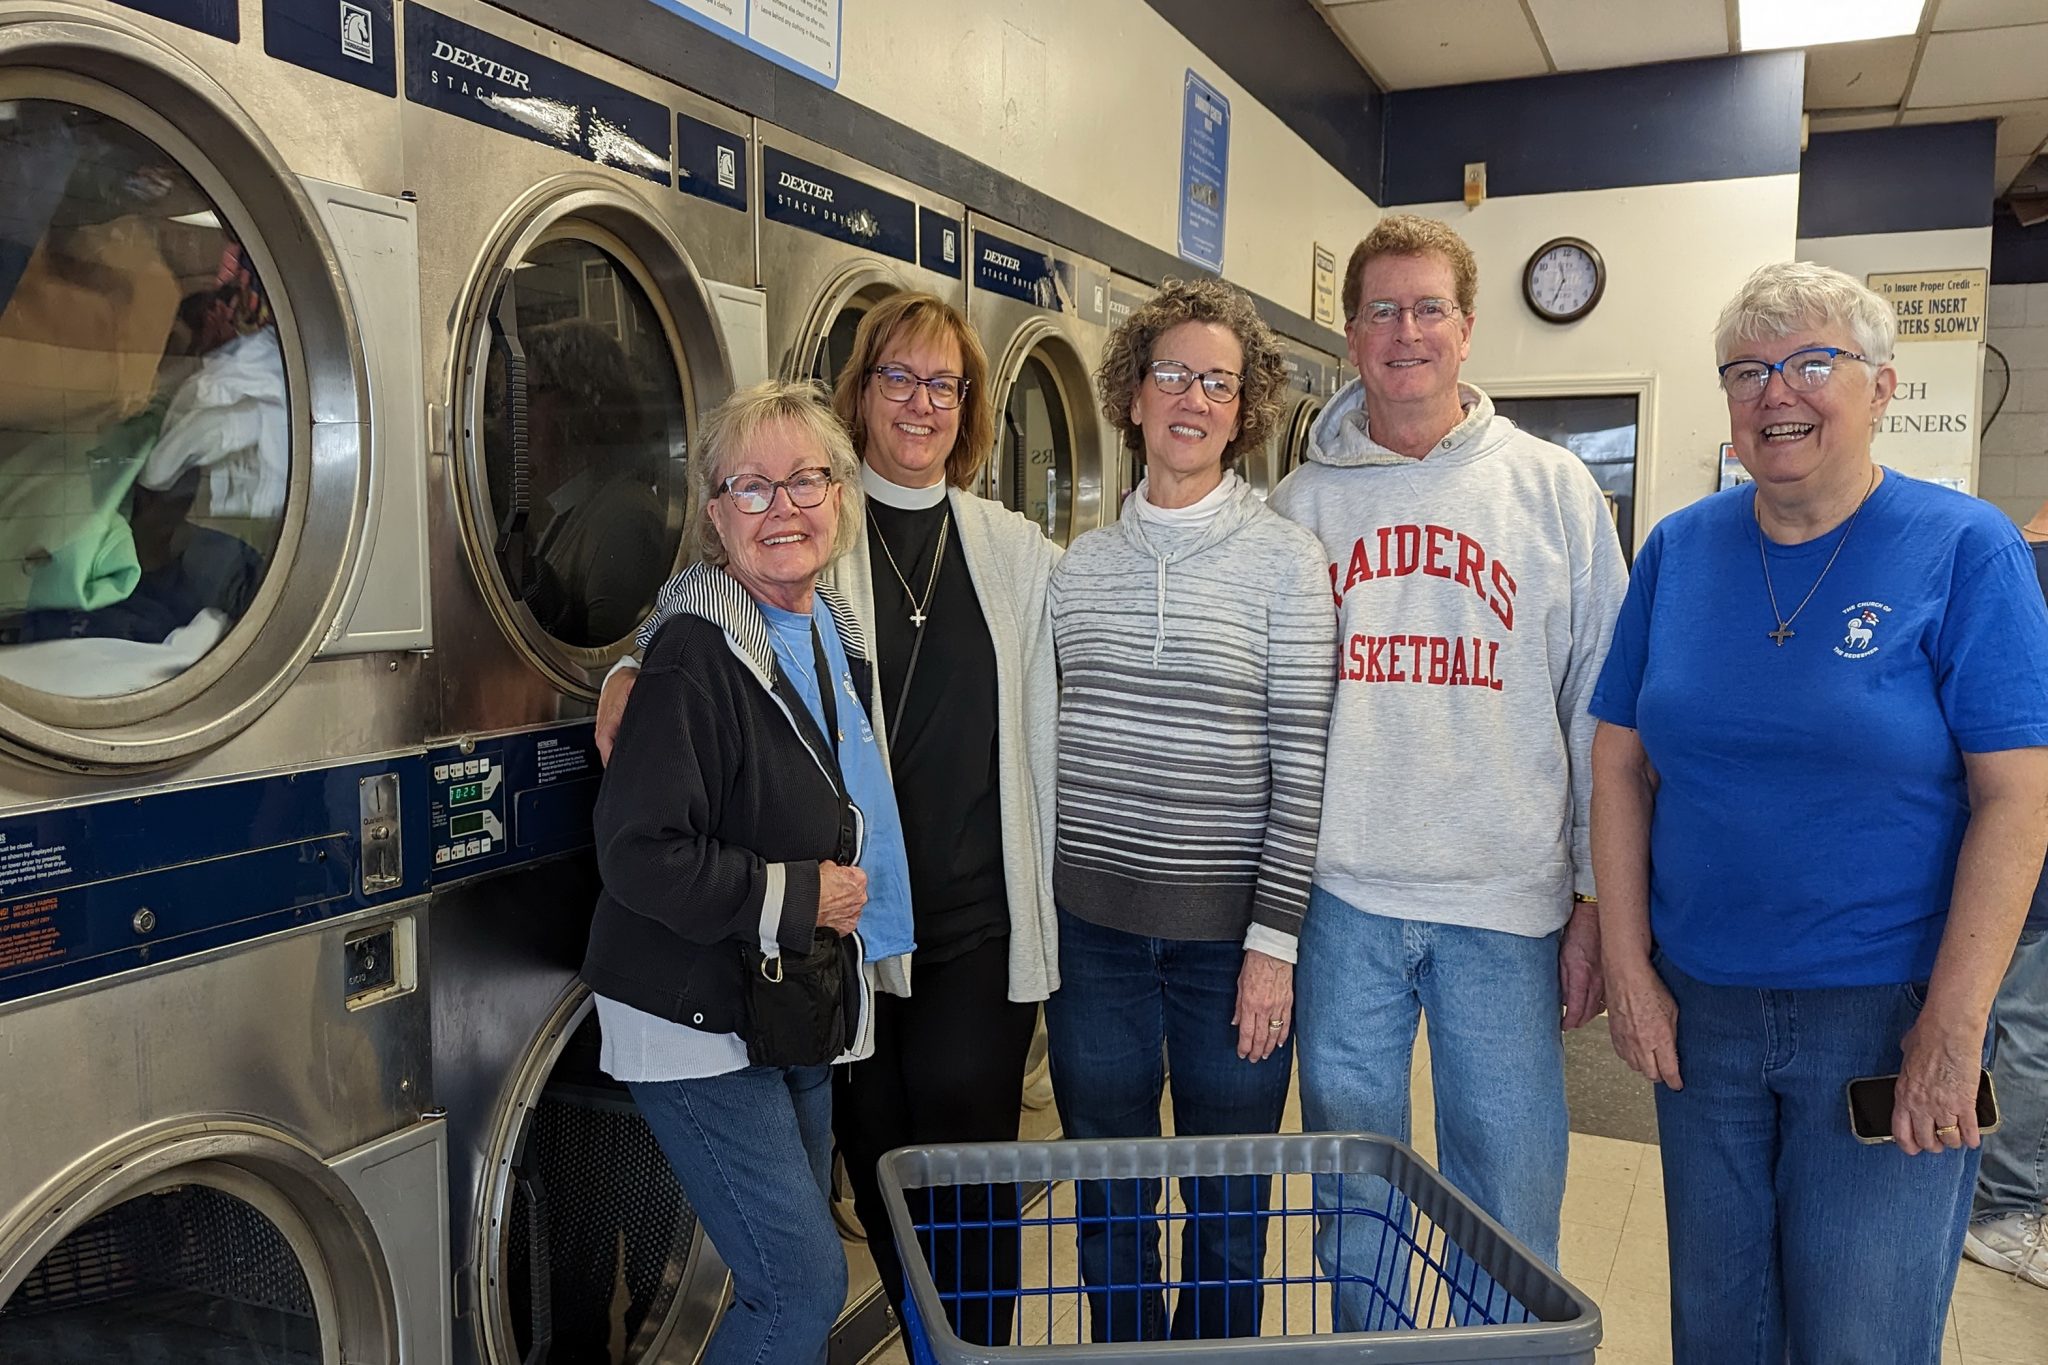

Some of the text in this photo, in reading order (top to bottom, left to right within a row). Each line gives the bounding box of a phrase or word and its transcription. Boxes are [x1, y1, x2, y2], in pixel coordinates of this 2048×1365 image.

[432, 40, 531, 92] DEXTER
[779, 171, 834, 202] DEXTER
[778, 194, 816, 216] STACK
[983, 249, 1020, 271] DEXTER
[1549, 252, 1557, 260] 11
[1563, 249, 1572, 257] 12
[982, 266, 1008, 283] STACK
[1539, 262, 1548, 271] 10
[1884, 283, 1892, 293] To
[1895, 282, 1918, 292] Insure
[1920, 281, 1945, 293] Proper
[1947, 279, 1970, 290] Credit
[1109, 300, 1130, 316] EXTER
[1892, 298, 1967, 316] EASE INSERT
[1934, 316, 1980, 333] SLOWLY
[1892, 382, 1927, 401] CH
[1878, 414, 1967, 433] TENERS
[1842, 601, 1893, 615] THE CHURCH OF
[1833, 646, 1879, 659] THE REDEEMER
[0, 868, 19, 877] perature
